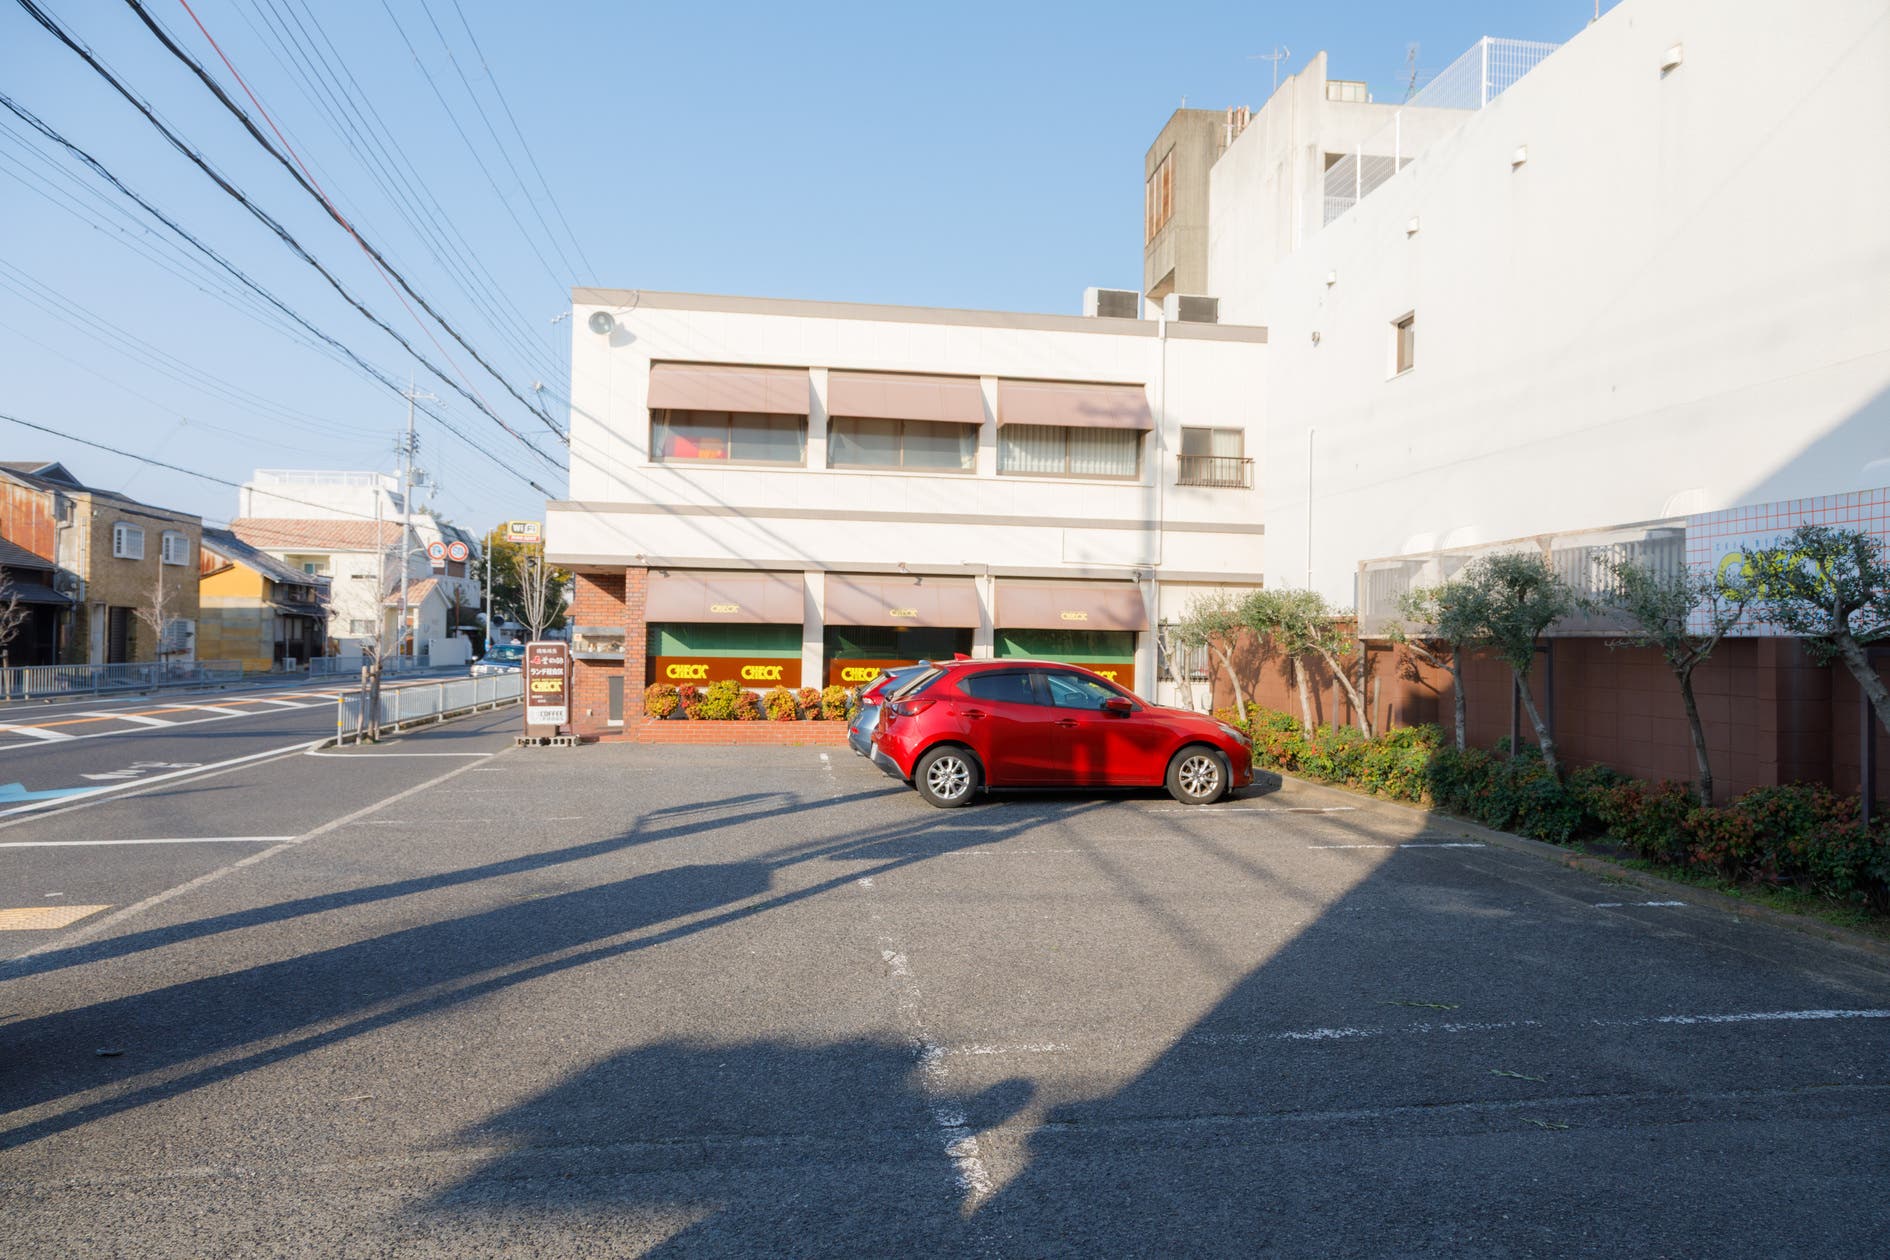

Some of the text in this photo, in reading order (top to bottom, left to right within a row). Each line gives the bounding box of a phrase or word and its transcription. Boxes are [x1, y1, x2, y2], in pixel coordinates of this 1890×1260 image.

[710, 604, 739, 613] CHECK
[889, 608, 918, 617] CHECK
[1060, 612, 1088, 621] CHECK
[666, 664, 710, 680] CHECK
[741, 665, 783, 680] CHECK
[841, 667, 880, 681] CHECK
[531, 681, 563, 692] CHECK
